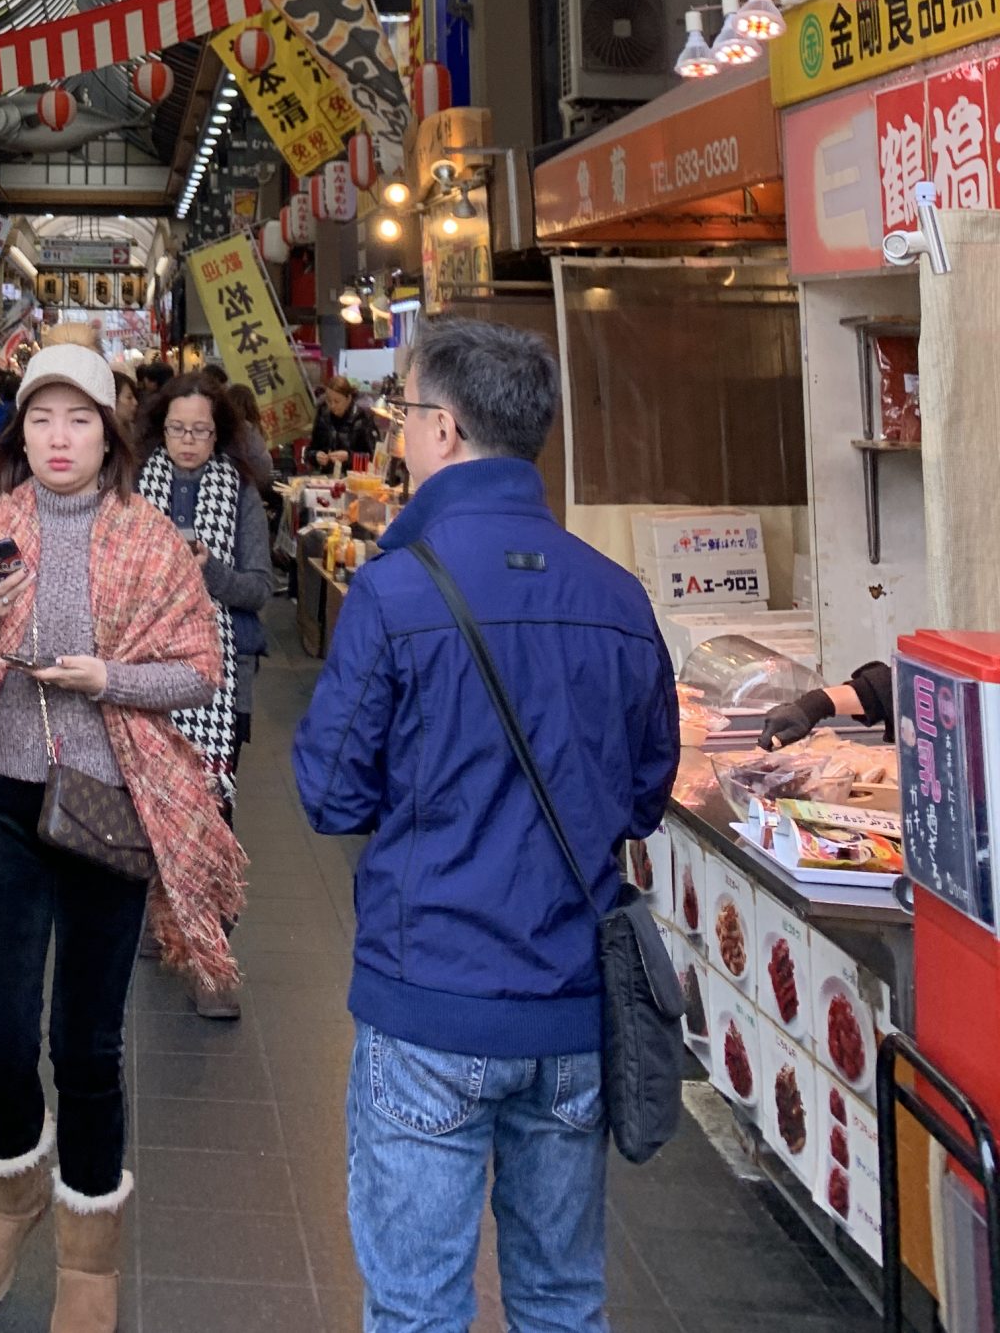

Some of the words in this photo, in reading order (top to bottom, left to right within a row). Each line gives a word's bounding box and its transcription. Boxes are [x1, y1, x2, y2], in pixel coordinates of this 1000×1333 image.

[650, 161, 673, 195] TEL
[675, 136, 738, 188] 633-0330
[881, 96, 1000, 229] 鶴橋
